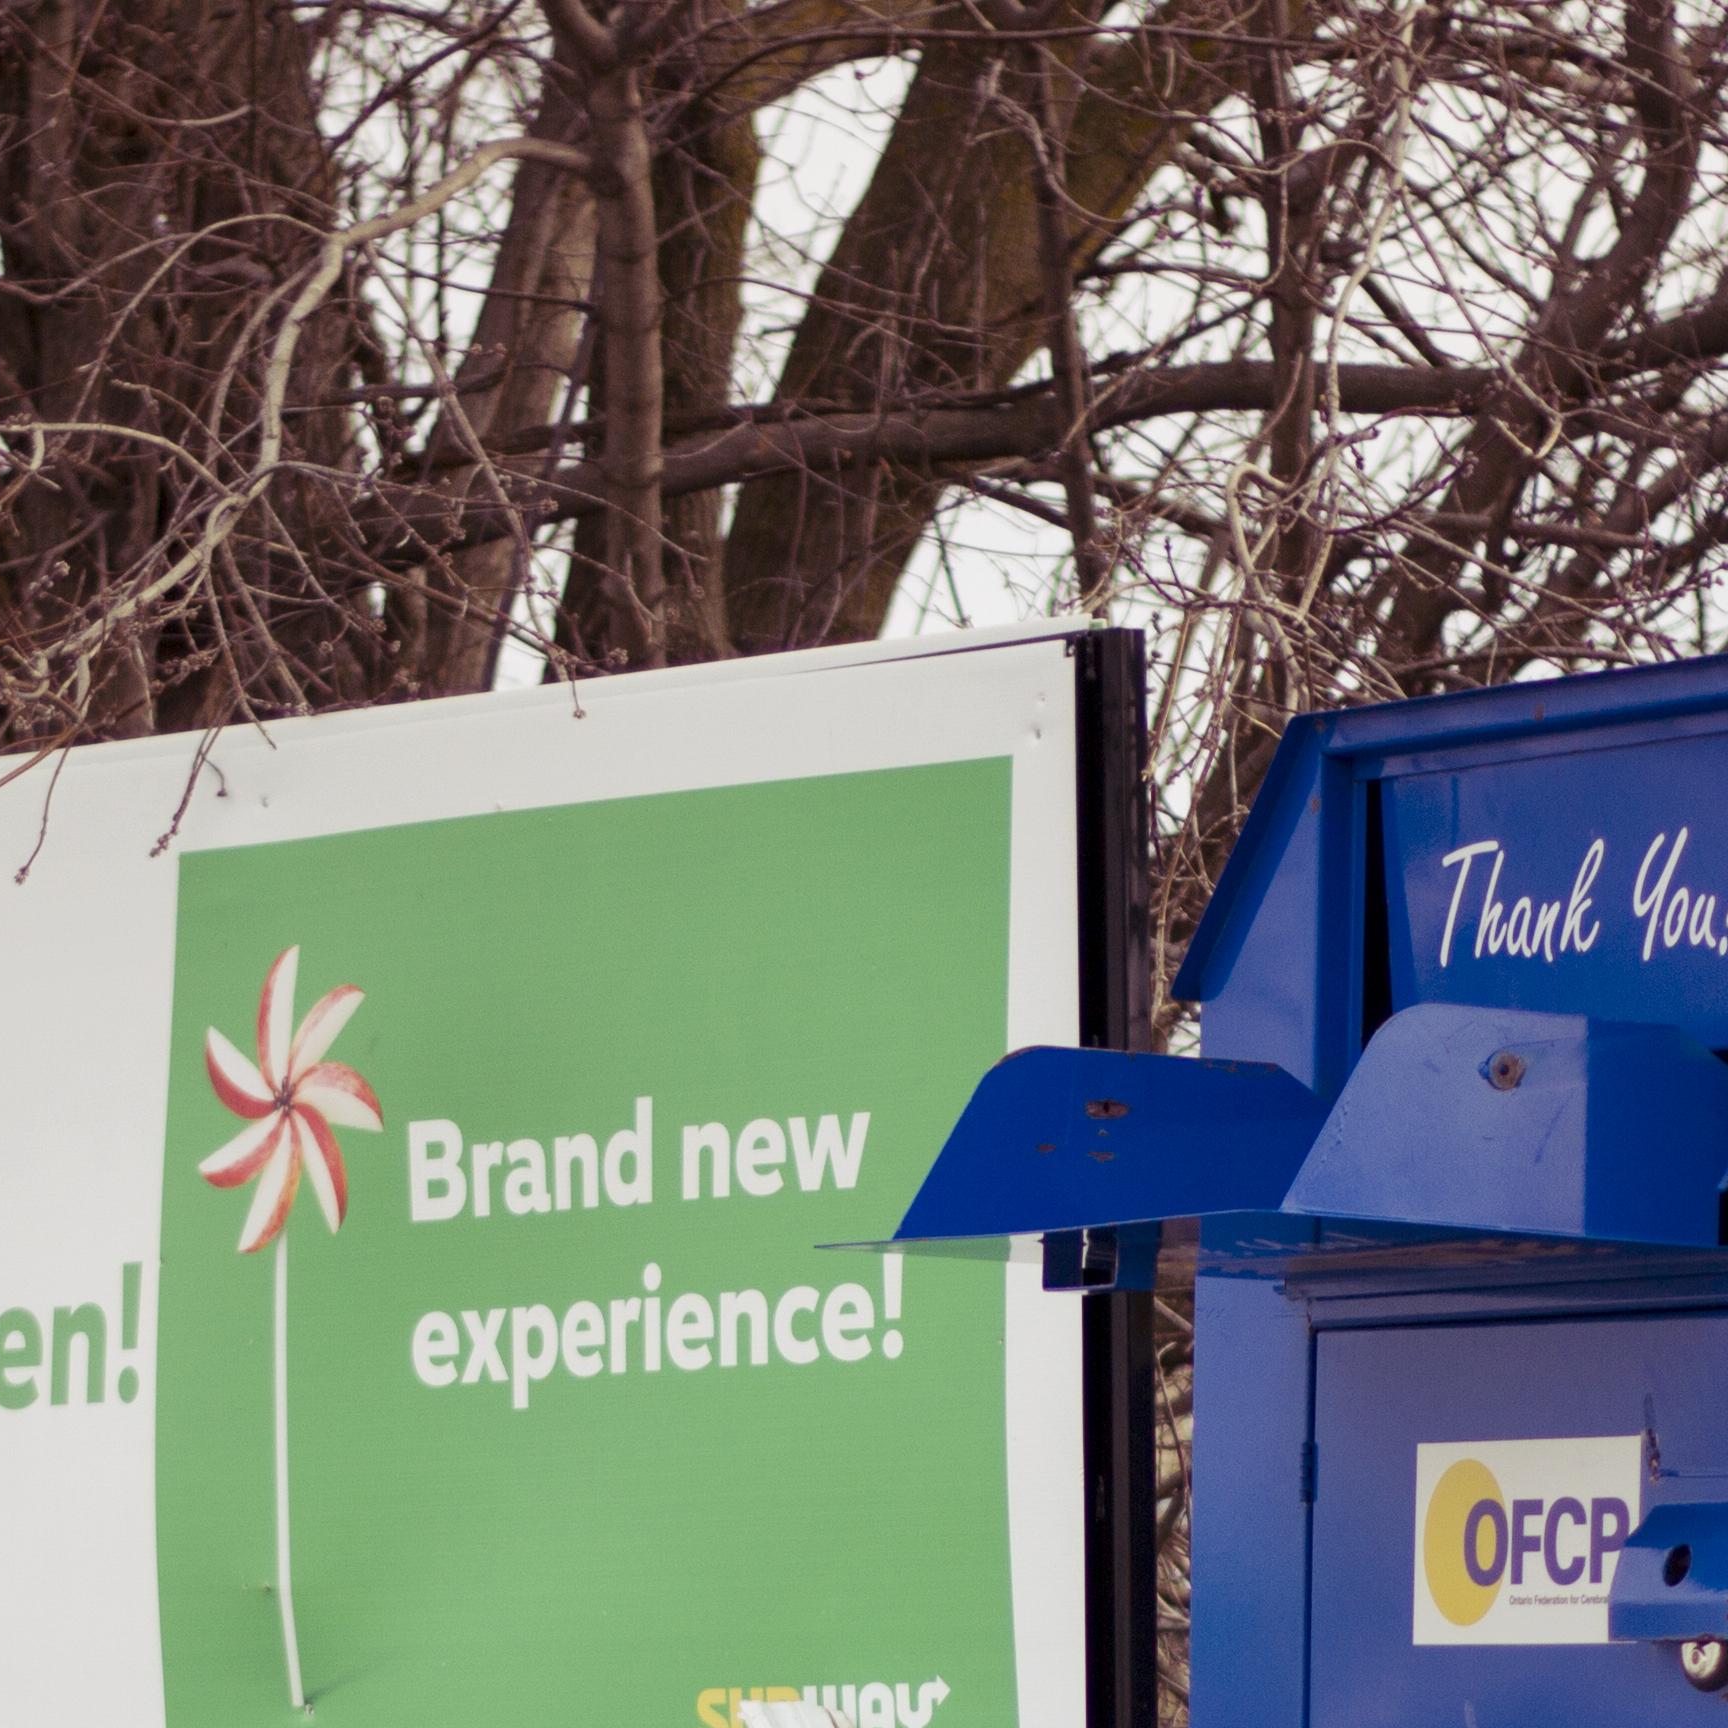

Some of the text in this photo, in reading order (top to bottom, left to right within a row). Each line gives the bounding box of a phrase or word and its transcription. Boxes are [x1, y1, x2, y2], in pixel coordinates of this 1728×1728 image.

[1440, 838, 1605, 968] Thank
[408, 1096, 871, 1222] Brand new
[411, 1252, 905, 1410] experience!
[1463, 1496, 1631, 1587] OFCP
